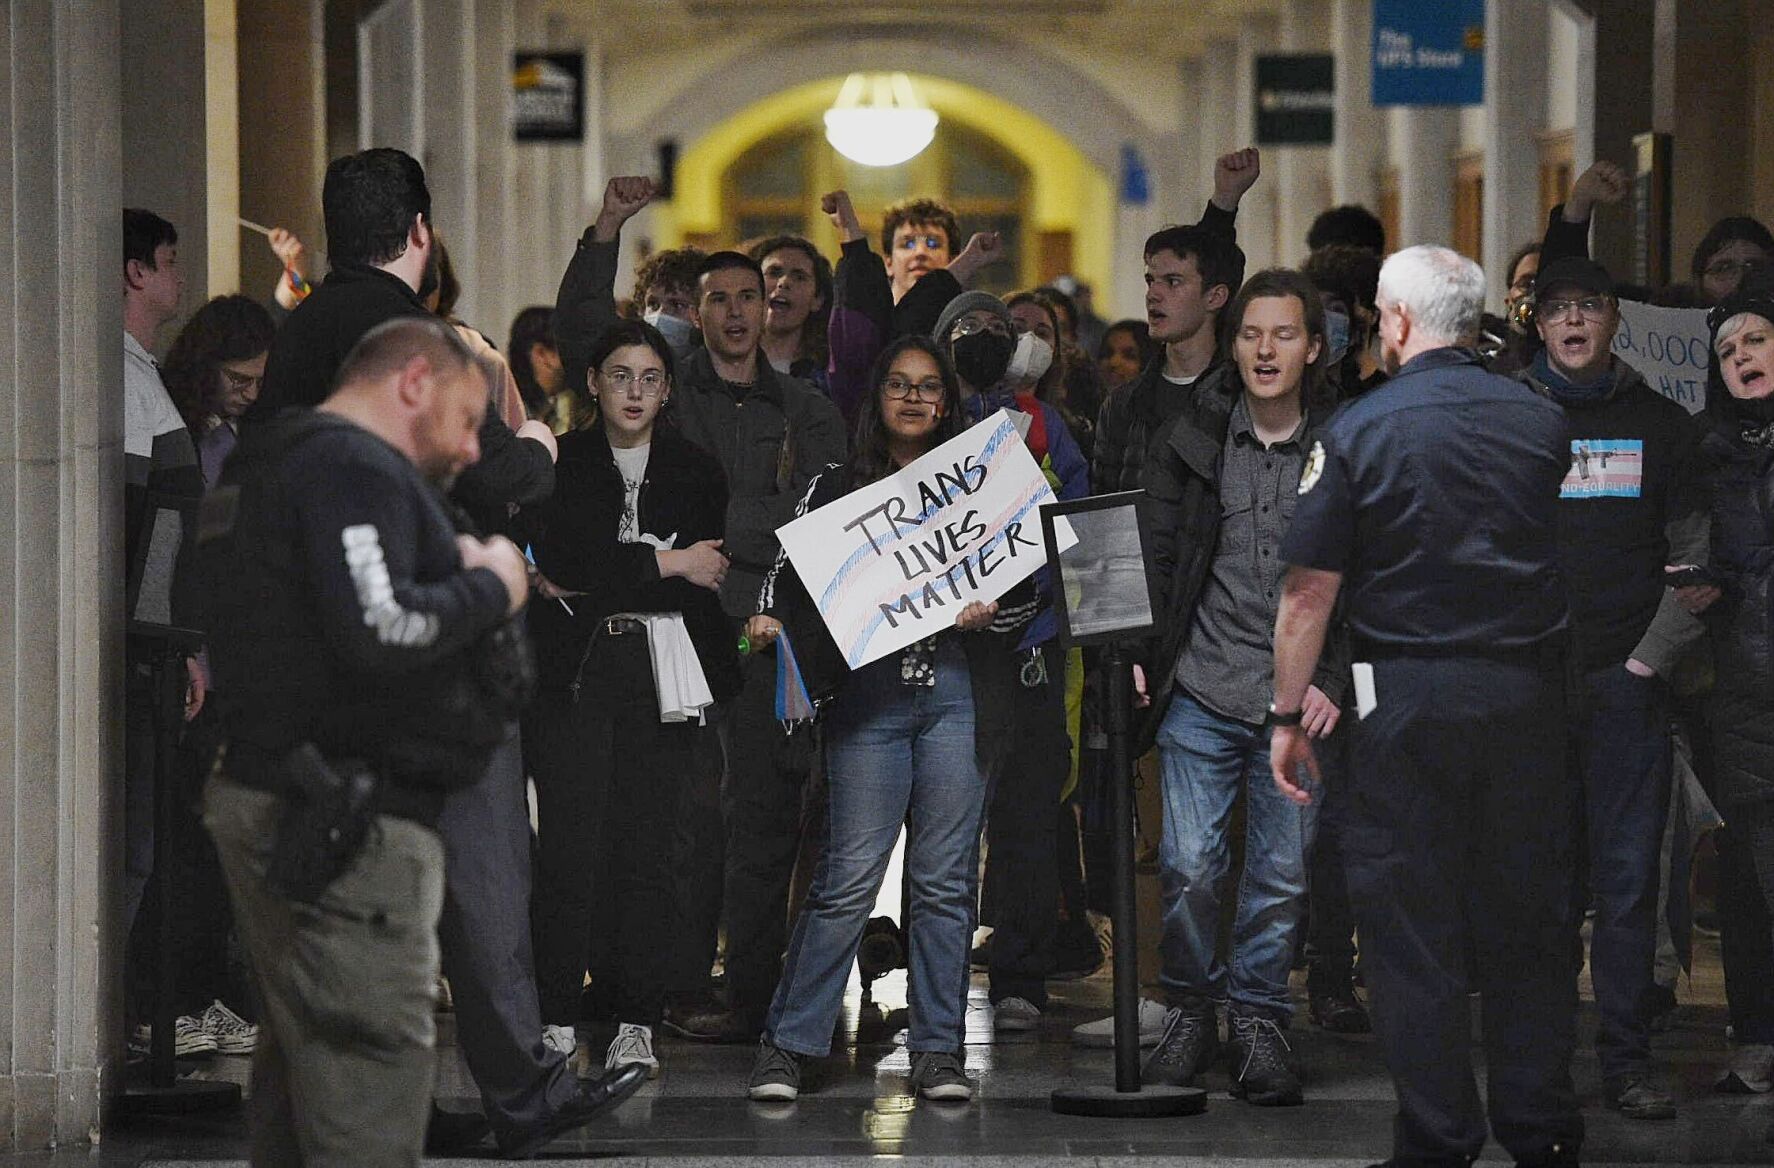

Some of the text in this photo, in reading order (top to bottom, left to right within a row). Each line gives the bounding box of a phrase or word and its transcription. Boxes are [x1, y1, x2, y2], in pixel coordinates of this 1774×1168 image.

[843, 455, 988, 556] TRANS
[893, 510, 987, 581] LIVES
[878, 522, 1039, 628] MATTER
